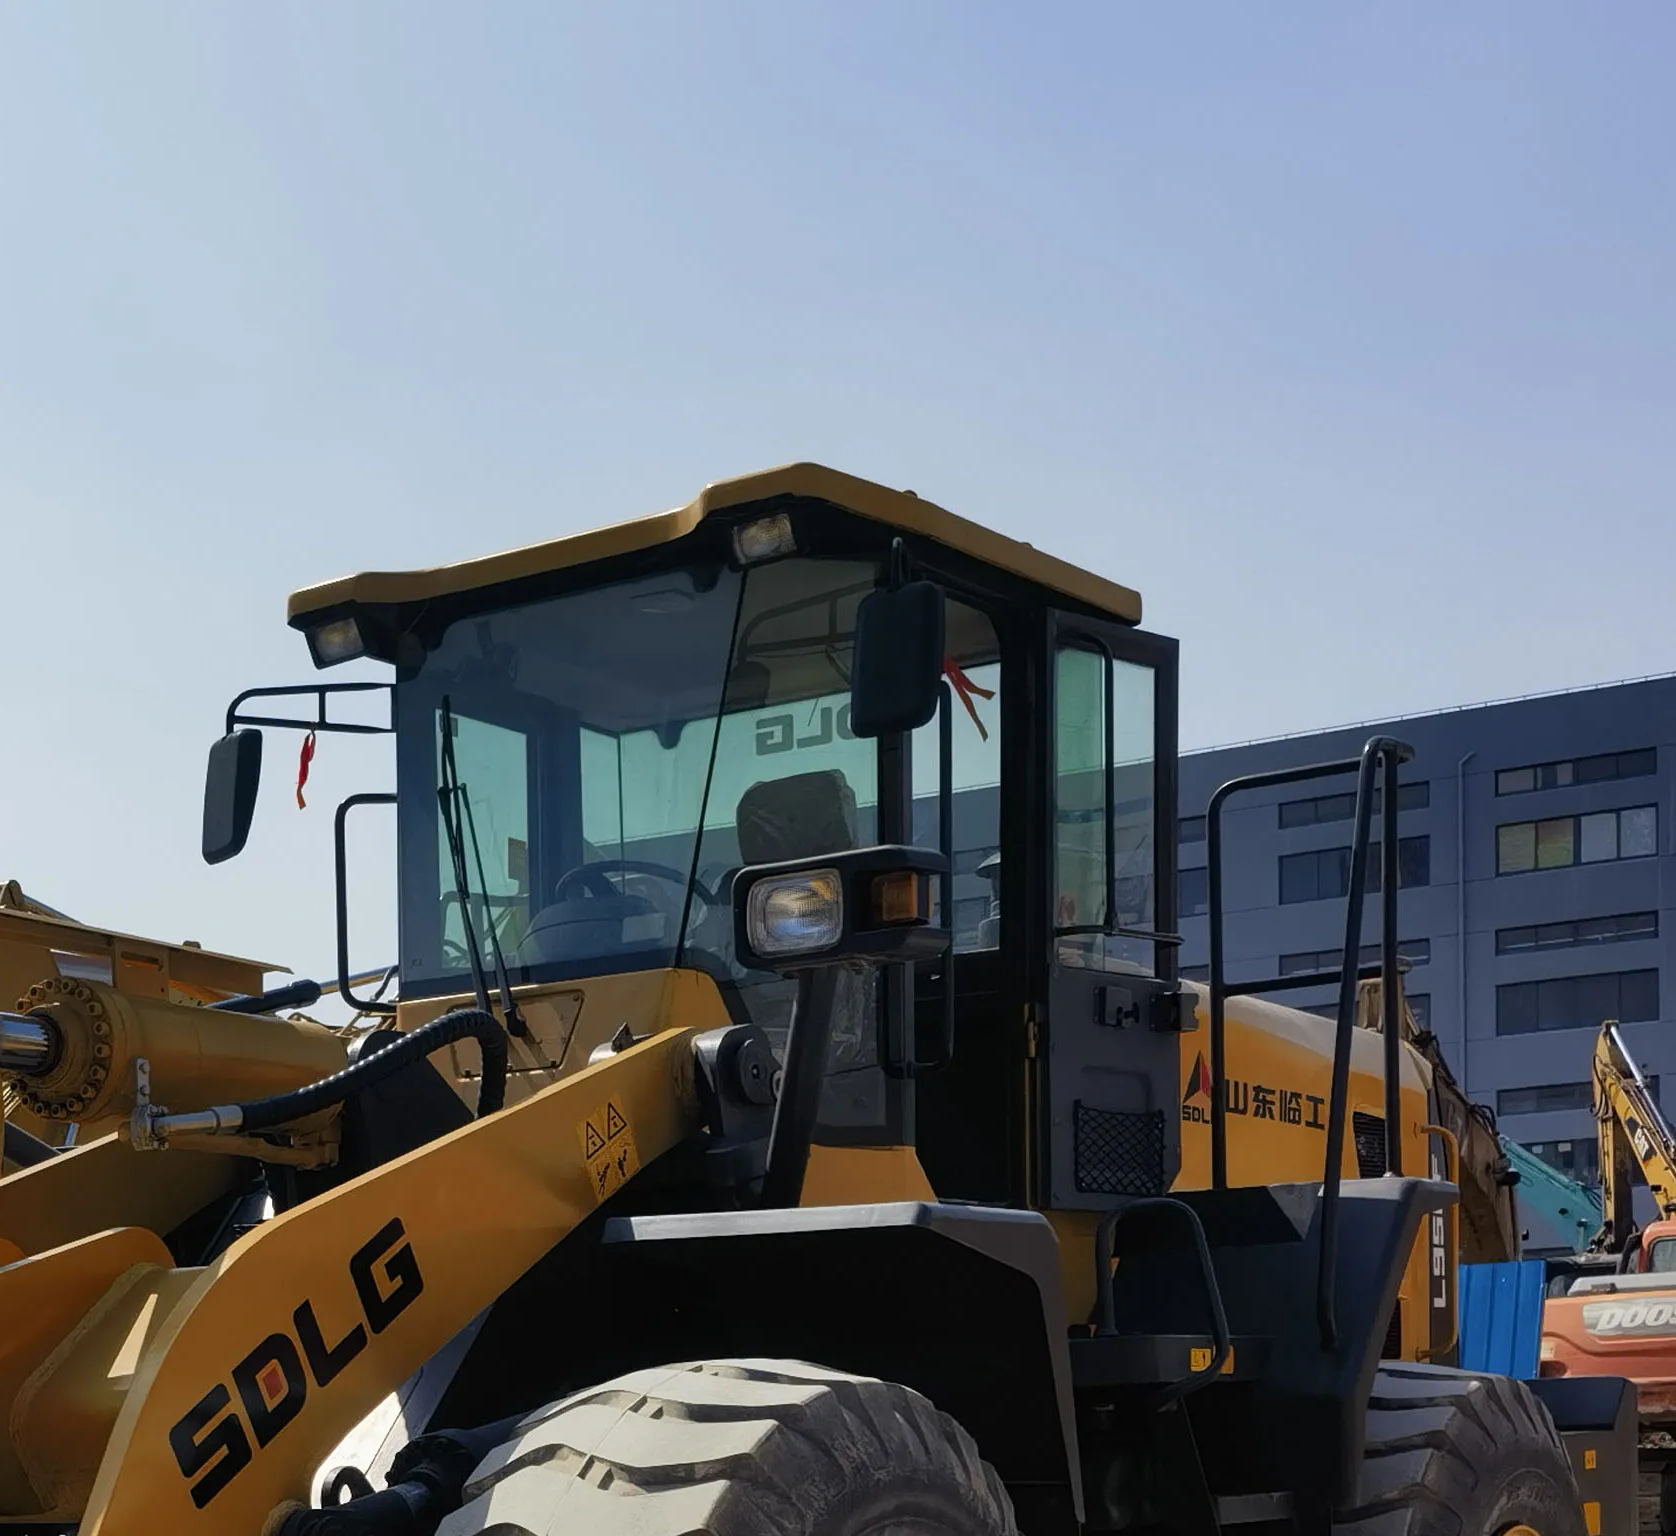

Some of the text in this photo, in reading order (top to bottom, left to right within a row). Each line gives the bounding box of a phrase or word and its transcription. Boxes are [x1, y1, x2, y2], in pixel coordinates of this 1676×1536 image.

[1182, 1105, 1211, 1124] SDL
[1224, 1078, 1325, 1130] 山东临工
[1432, 1153, 1446, 1308] L95F
[168, 1217, 424, 1510] SDLG
